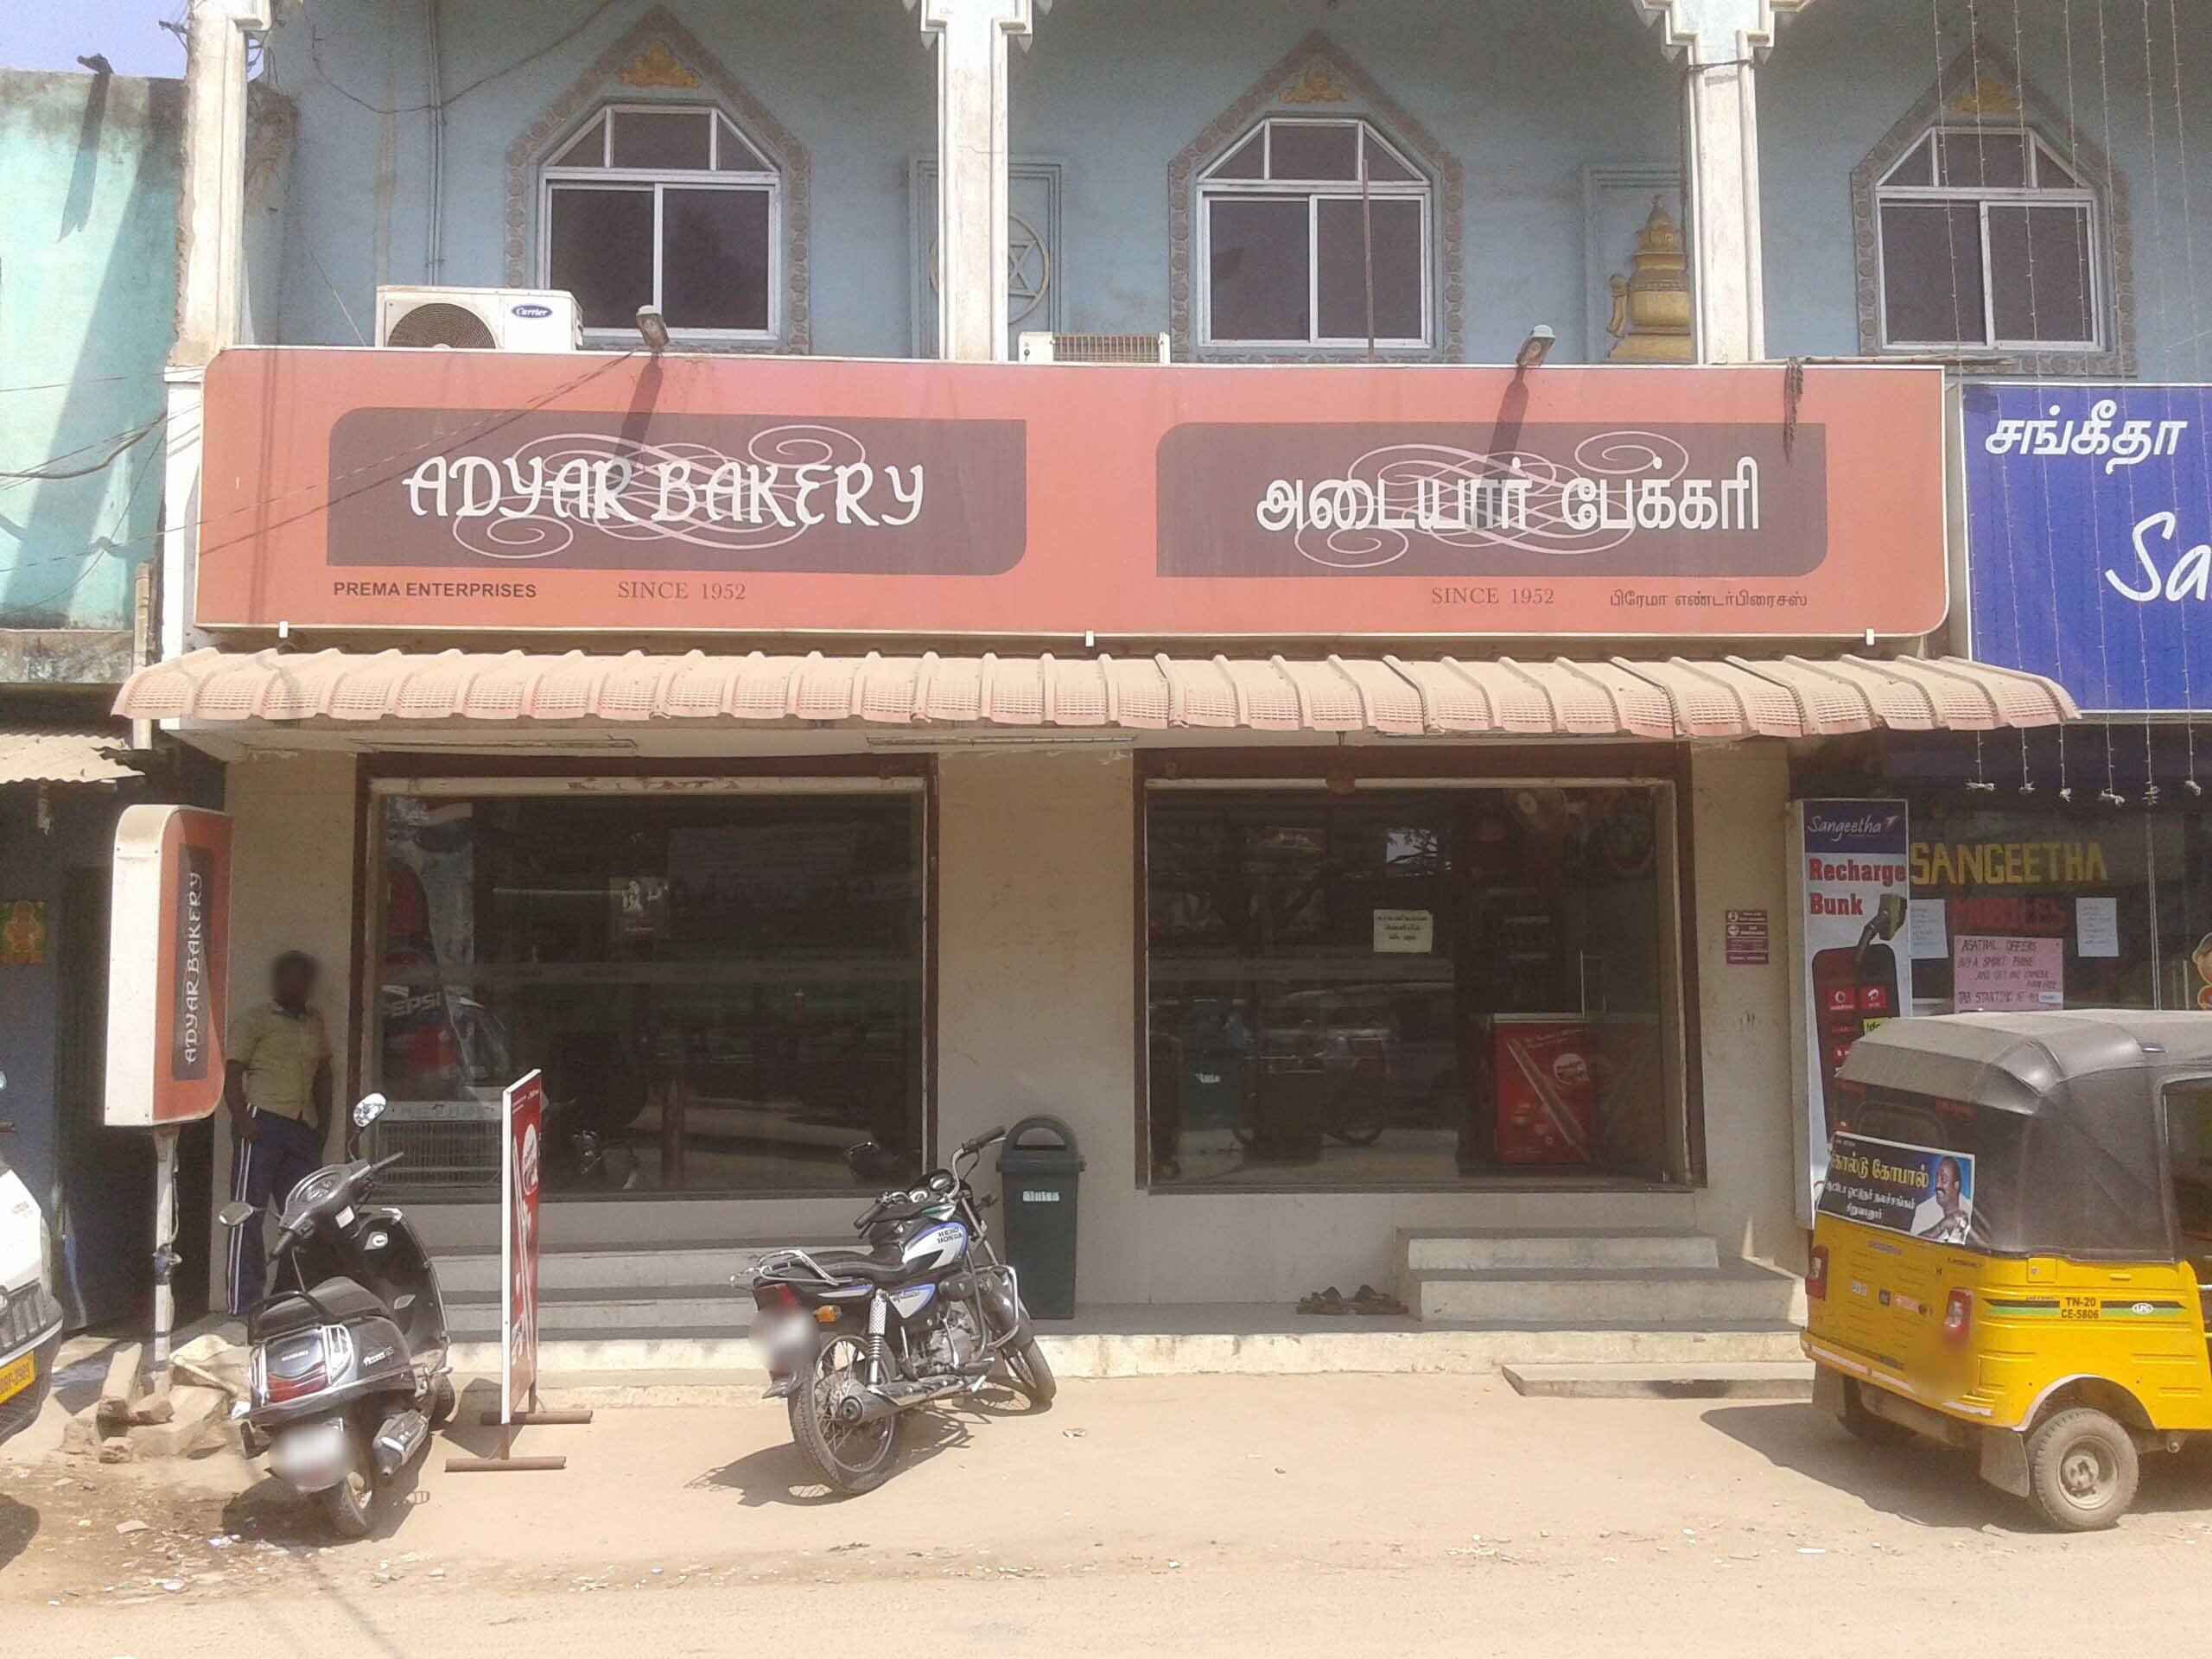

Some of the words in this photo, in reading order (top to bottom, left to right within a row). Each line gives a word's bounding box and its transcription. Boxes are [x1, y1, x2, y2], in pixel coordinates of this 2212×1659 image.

[516, 307, 549, 317] Carrier
[1985, 399, 2188, 475] சங்கீதா
[402, 456, 635, 522] ADYAR
[651, 460, 925, 527] BAKERY
[1255, 455, 1533, 531] அடையார்
[1561, 455, 1760, 531] பேக்கரி
[333, 582, 401, 597] PREMA
[405, 582, 537, 599] ENTERPRISES
[617, 581, 690, 600] SINCE
[701, 582, 747, 601] 1952
[1431, 587, 1500, 604] SINCE
[1510, 587, 1555, 605] 1952
[1610, 588, 1669, 608] பிரேமா
[1807, 814, 1882, 842] Sangeetha
[1808, 857, 1906, 888] Recharge
[1909, 842, 2108, 886] SANGEETHA
[1809, 892, 1864, 916] Bunk
[186, 872, 203, 977] BAKERY
[183, 980, 201, 1064] ADYAR
[1872, 1158, 1929, 1190] கோபால்
[938, 1227, 959, 1237] HERO
[938, 1232, 963, 1244] HONDA
[2061, 1308, 2100, 1319] CE-5806
[2064, 1297, 2097, 1308] TN-20
